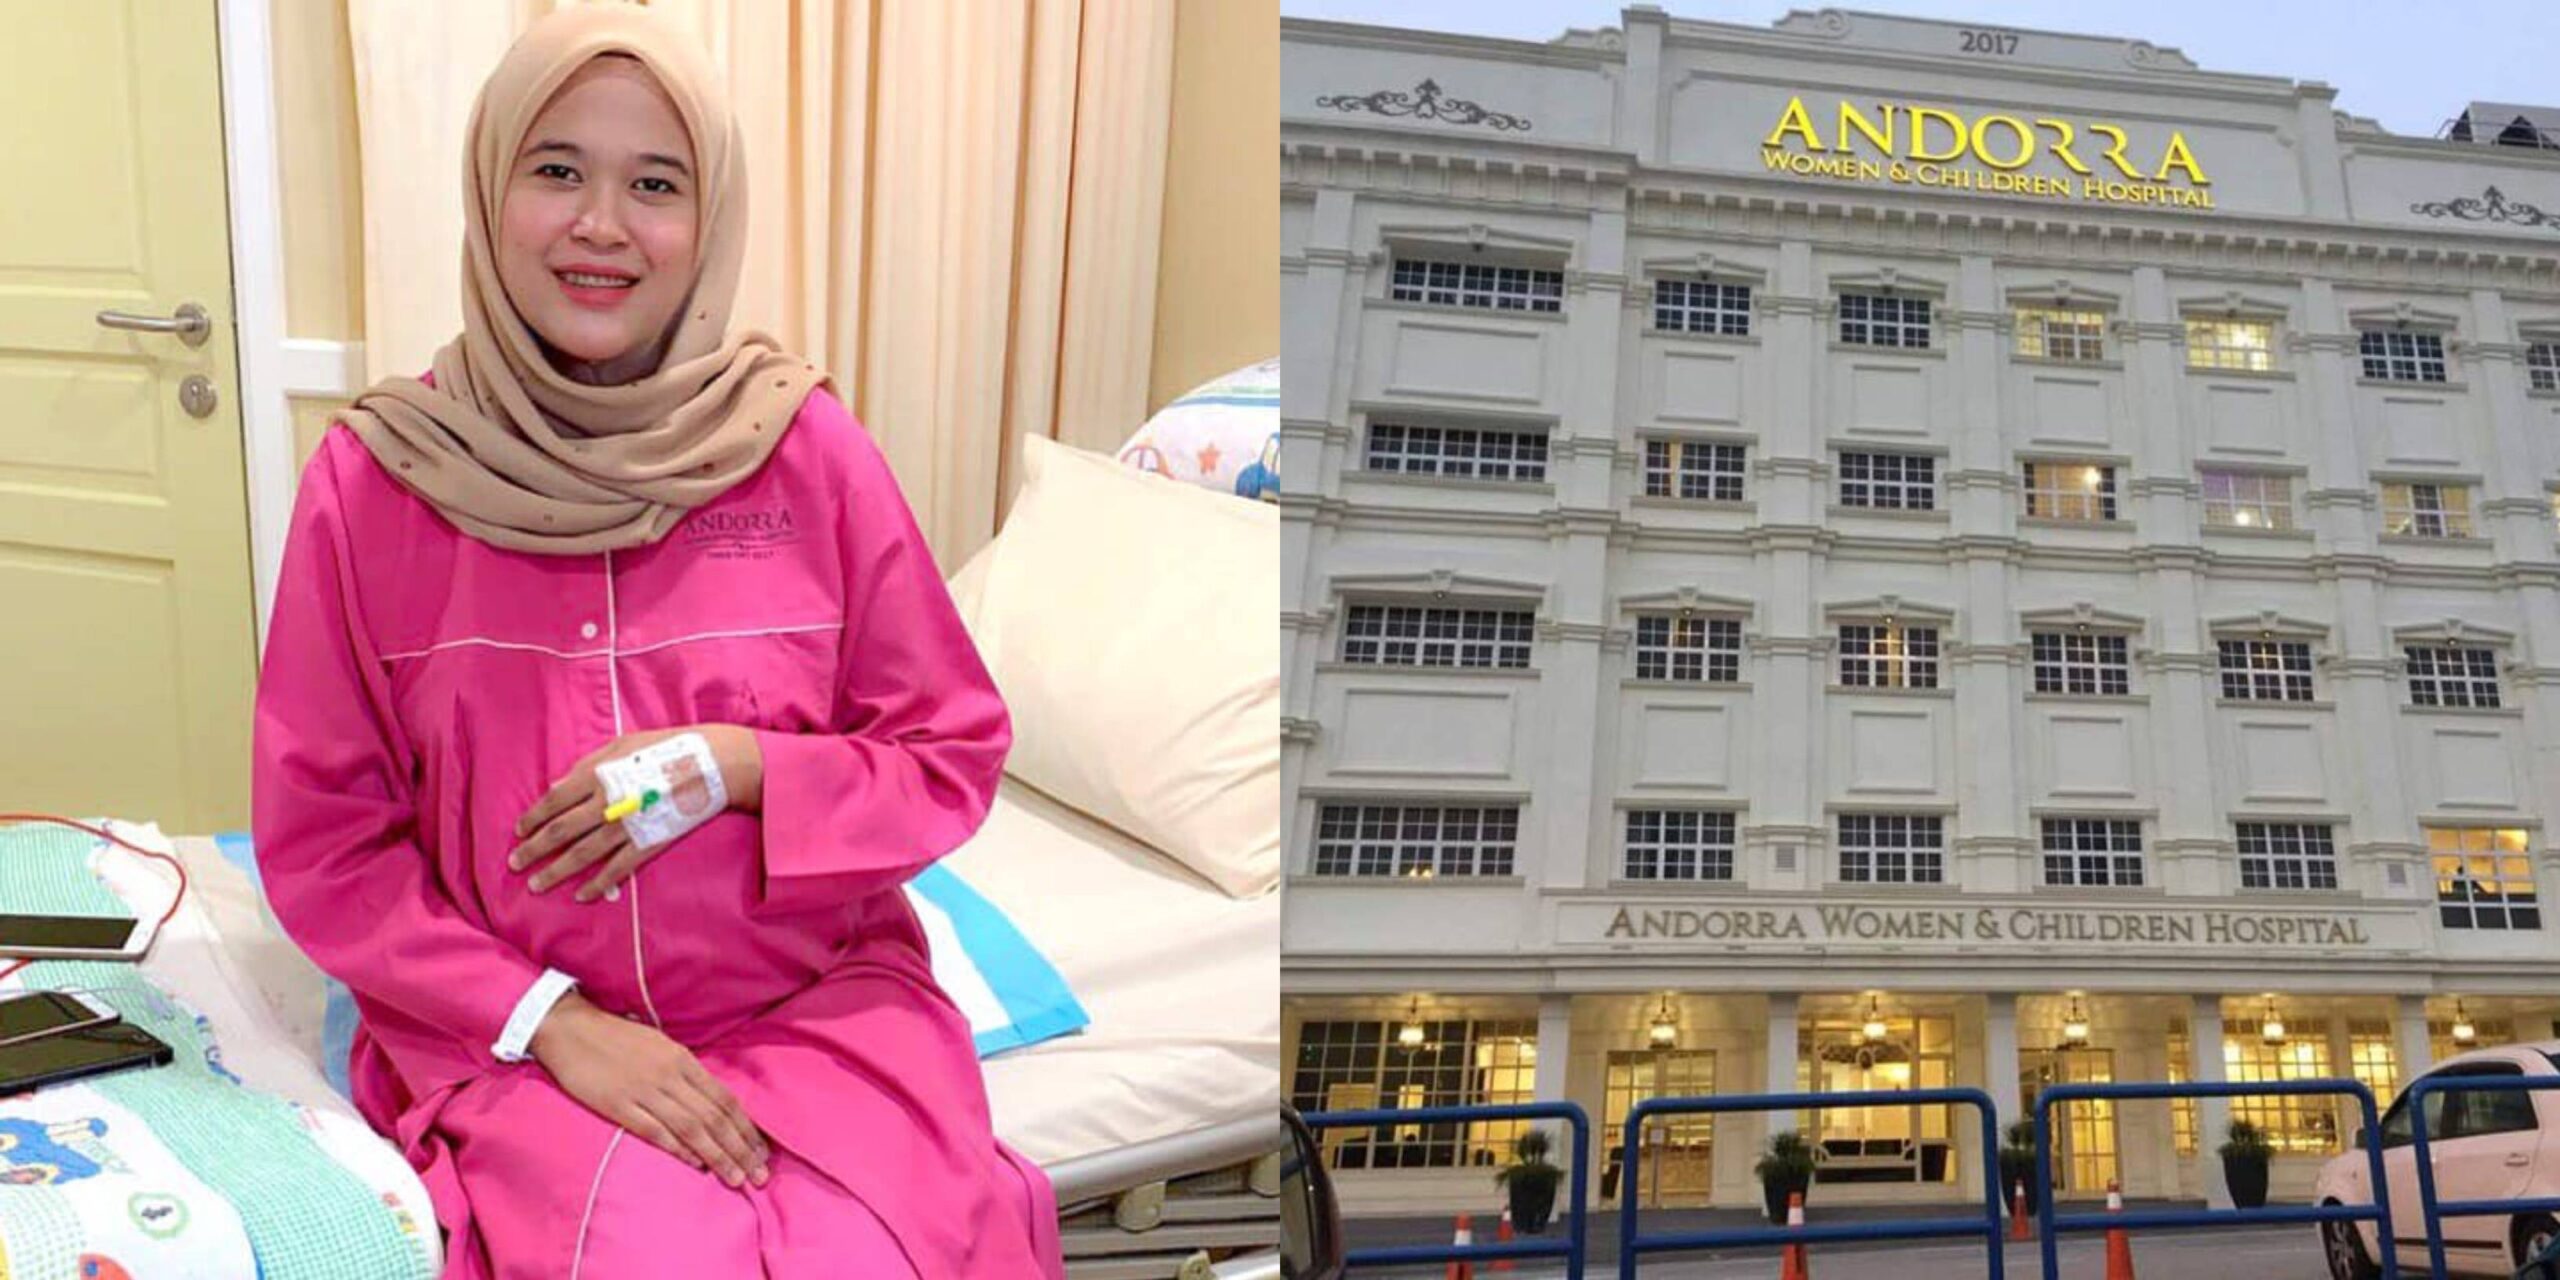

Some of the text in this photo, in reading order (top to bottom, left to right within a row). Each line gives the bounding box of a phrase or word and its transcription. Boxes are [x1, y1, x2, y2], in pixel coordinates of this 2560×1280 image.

[1959, 30, 2019, 55] 2017
[1762, 95, 2211, 186] ANDORRA
[1761, 148, 2217, 209] WOMEN & CHILDREN HOSPITAL
[684, 509, 792, 534] ANDORRA
[1605, 904, 2369, 945] ANDORRA WOMEN & CHILDREN HOSPITAL
